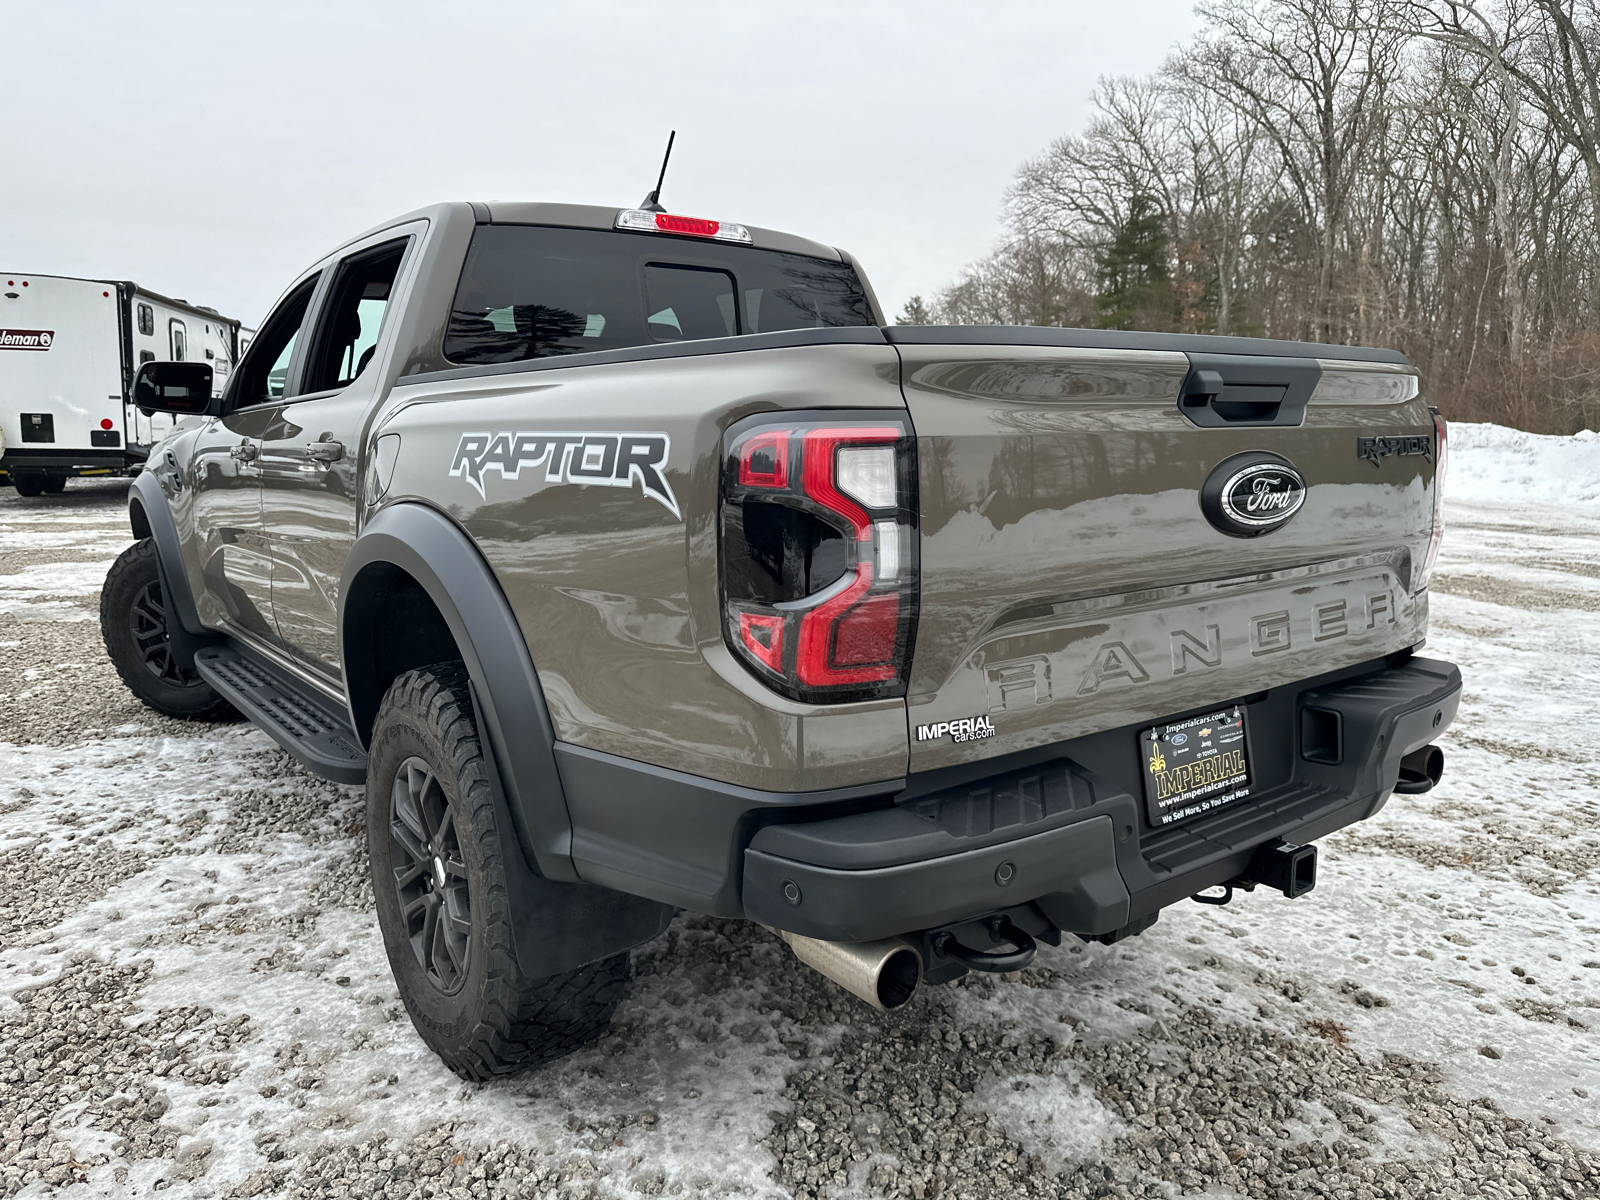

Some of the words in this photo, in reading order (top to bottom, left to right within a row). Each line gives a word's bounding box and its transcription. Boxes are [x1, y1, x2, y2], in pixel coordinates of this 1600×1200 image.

[0, 331, 39, 346] leman
[1357, 434, 1432, 468] RAPTOR
[448, 431, 682, 521] RAPTOR
[1247, 477, 1291, 511] Ford
[983, 588, 1397, 714] RANGER
[916, 714, 995, 741] IMPERIAL
[953, 728, 995, 743] cars.com
[1165, 712, 1226, 734] Imperialcars.com
[1155, 750, 1246, 799] IMPERIAL
[1158, 773, 1247, 808] www.imperialcars.com
[1162, 814, 1172, 824] We
[1173, 810, 1185, 819] Sell
[1185, 805, 1202, 815] More,
[1202, 802, 1210, 810] So
[1210, 797, 1222, 807] You
[1221, 791, 1235, 803] Save
[1235, 789, 1250, 799] More
